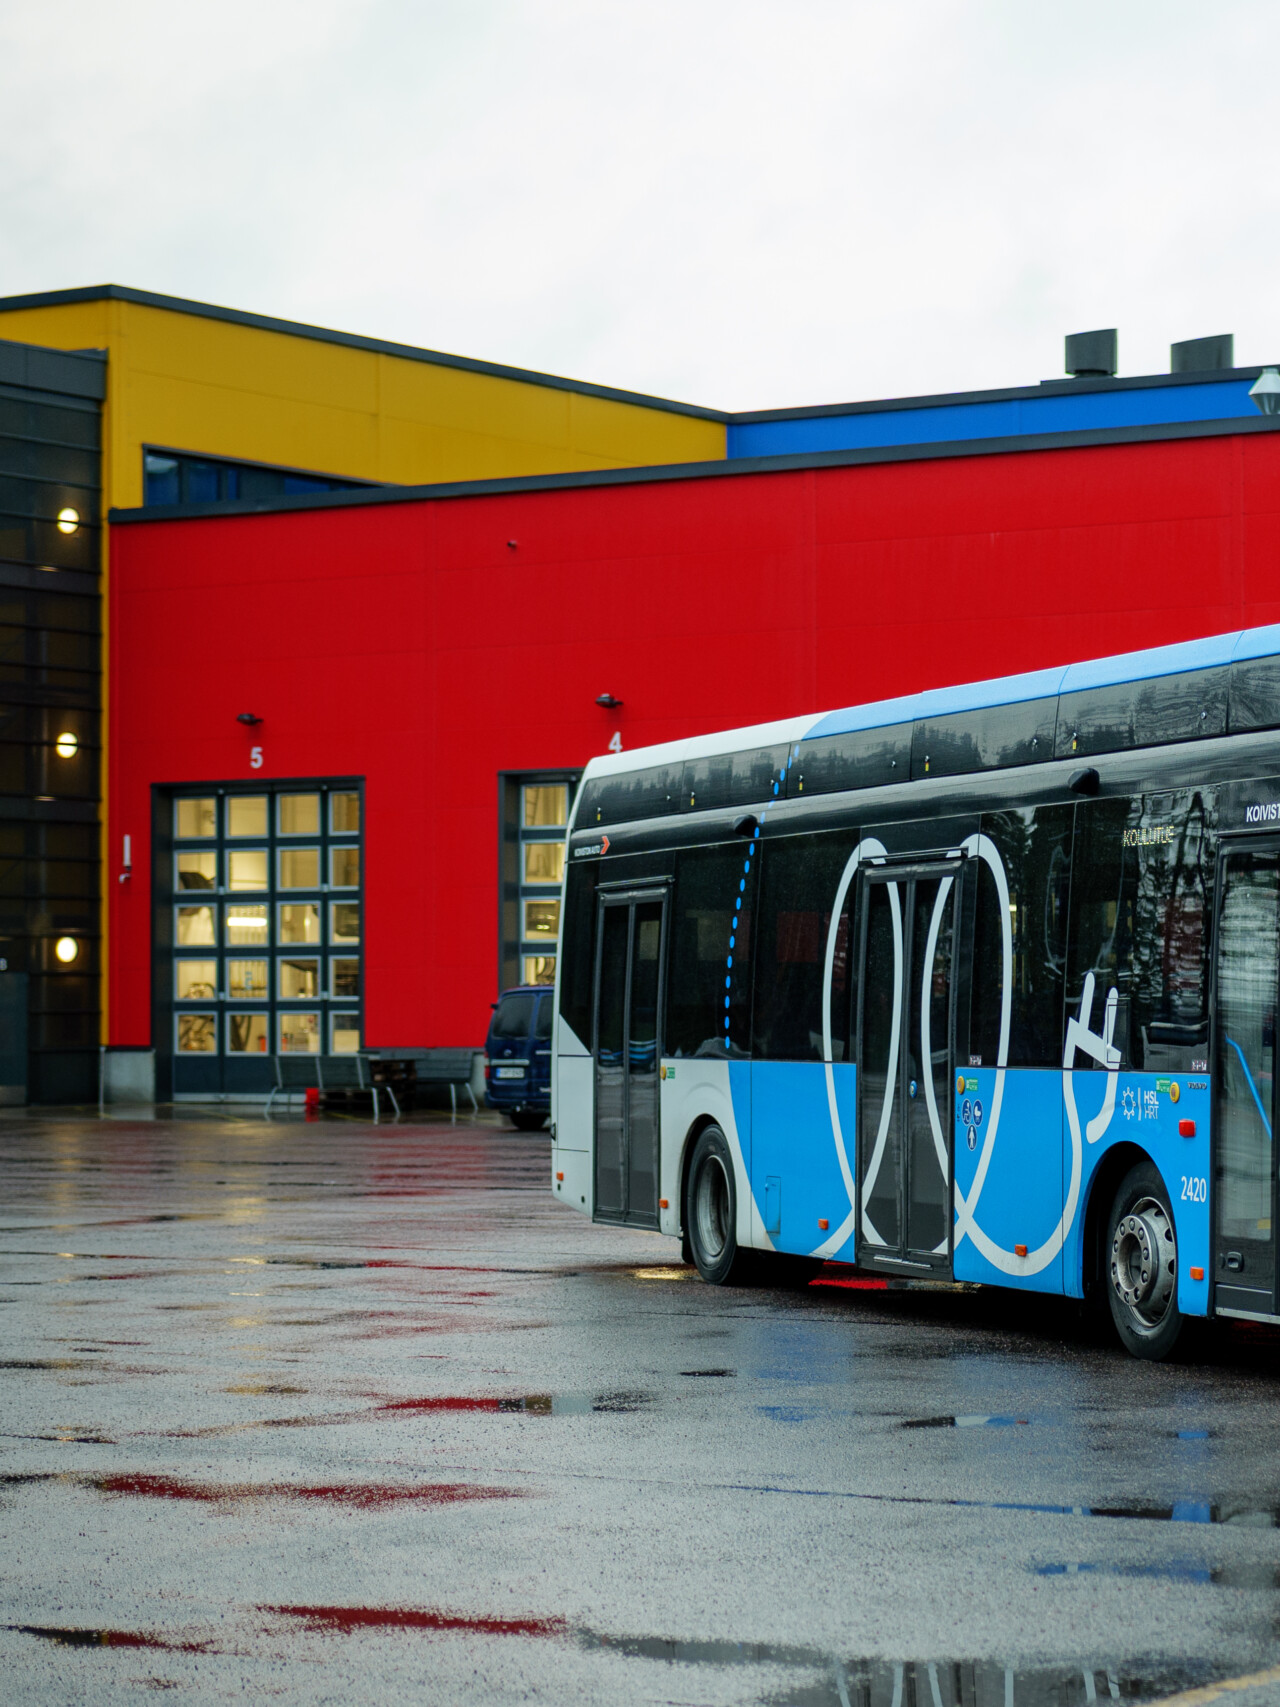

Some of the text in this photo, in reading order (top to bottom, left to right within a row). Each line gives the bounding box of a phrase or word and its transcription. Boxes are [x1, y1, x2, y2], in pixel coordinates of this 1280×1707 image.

[608, 731, 623, 753] 4
[250, 746, 263, 769] 5
[1144, 1090, 1159, 1104] HSL
[1144, 1105, 1159, 1119] HRT
[1181, 1176, 1207, 1202] 2420
